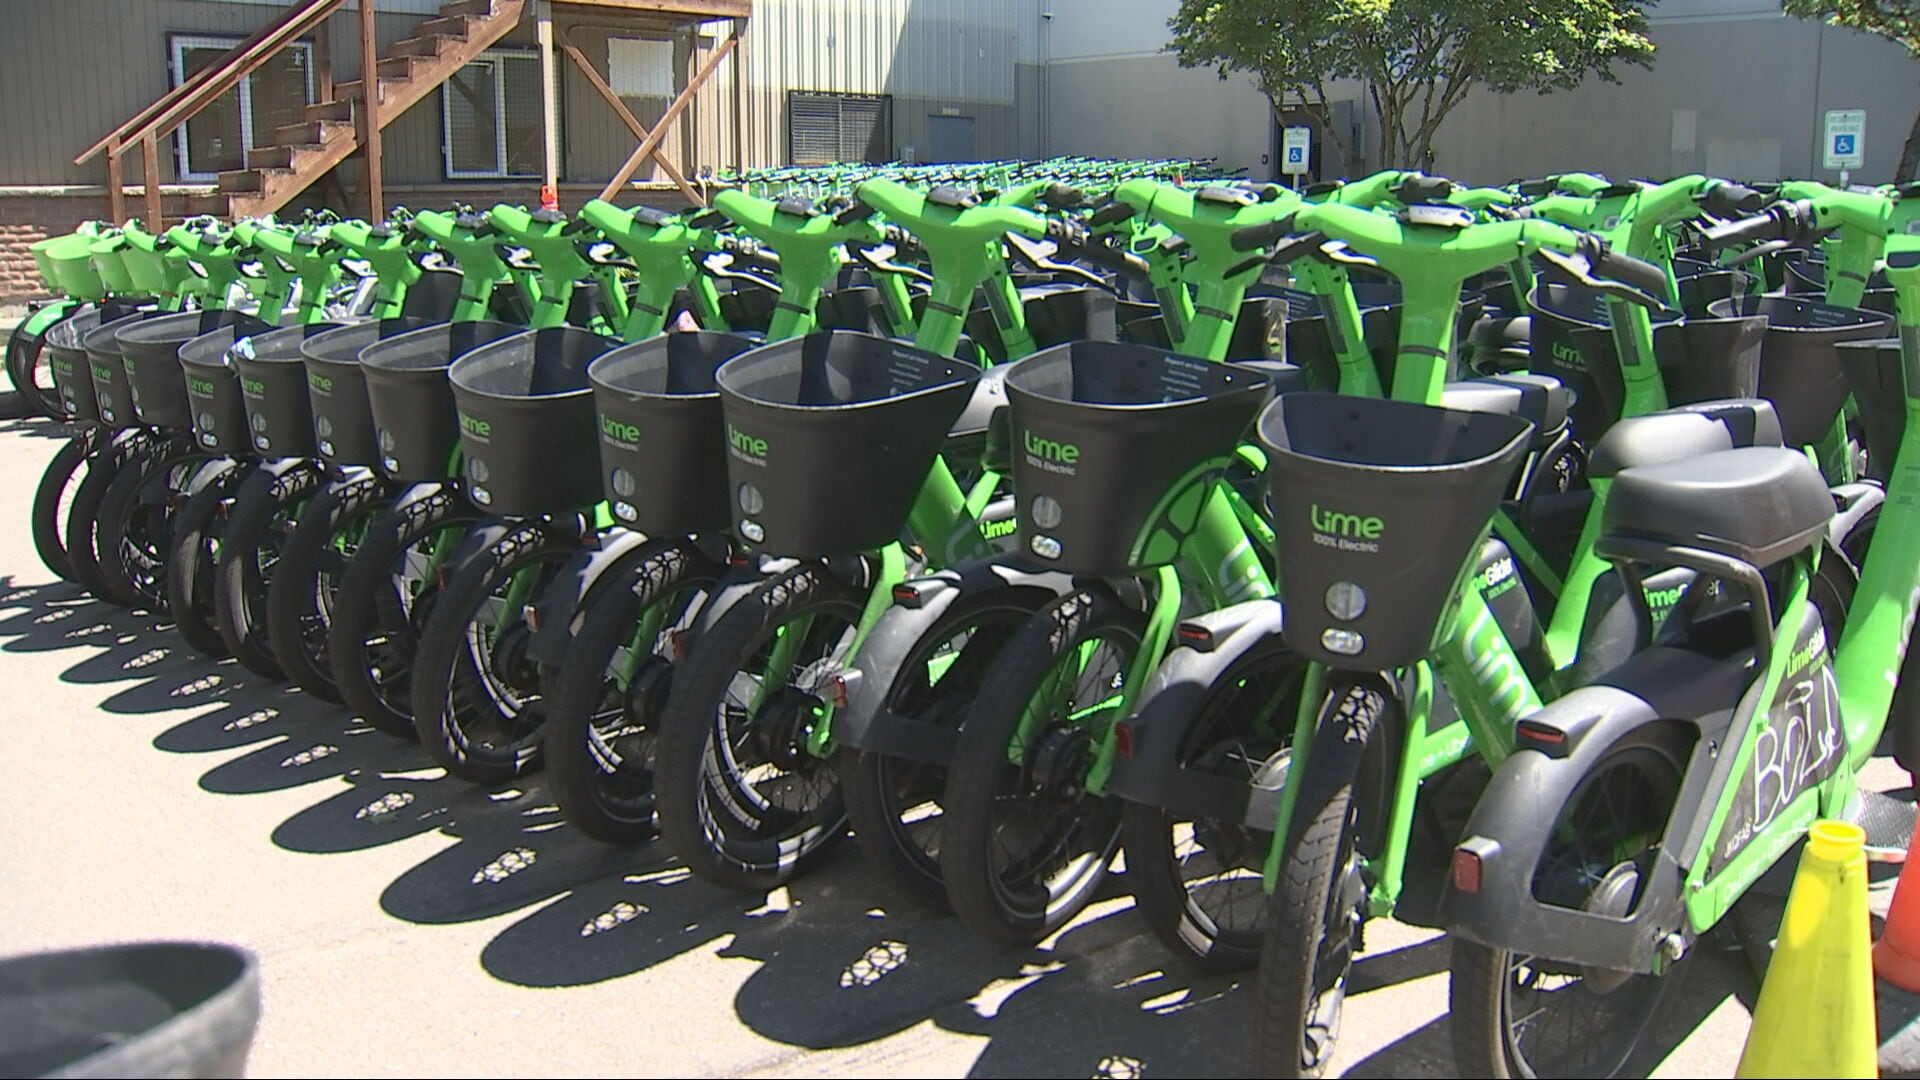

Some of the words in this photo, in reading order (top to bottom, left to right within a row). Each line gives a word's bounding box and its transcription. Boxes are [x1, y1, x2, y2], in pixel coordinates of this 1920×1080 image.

[600, 413, 641, 442] Lime
[728, 423, 768, 457] Lime
[1024, 429, 1080, 464] Lime
[1311, 503, 1384, 539] Lime
[1313, 532, 1338, 548] 100%
[1338, 538, 1379, 553] Electric
[1462, 604, 1543, 725] Lim
